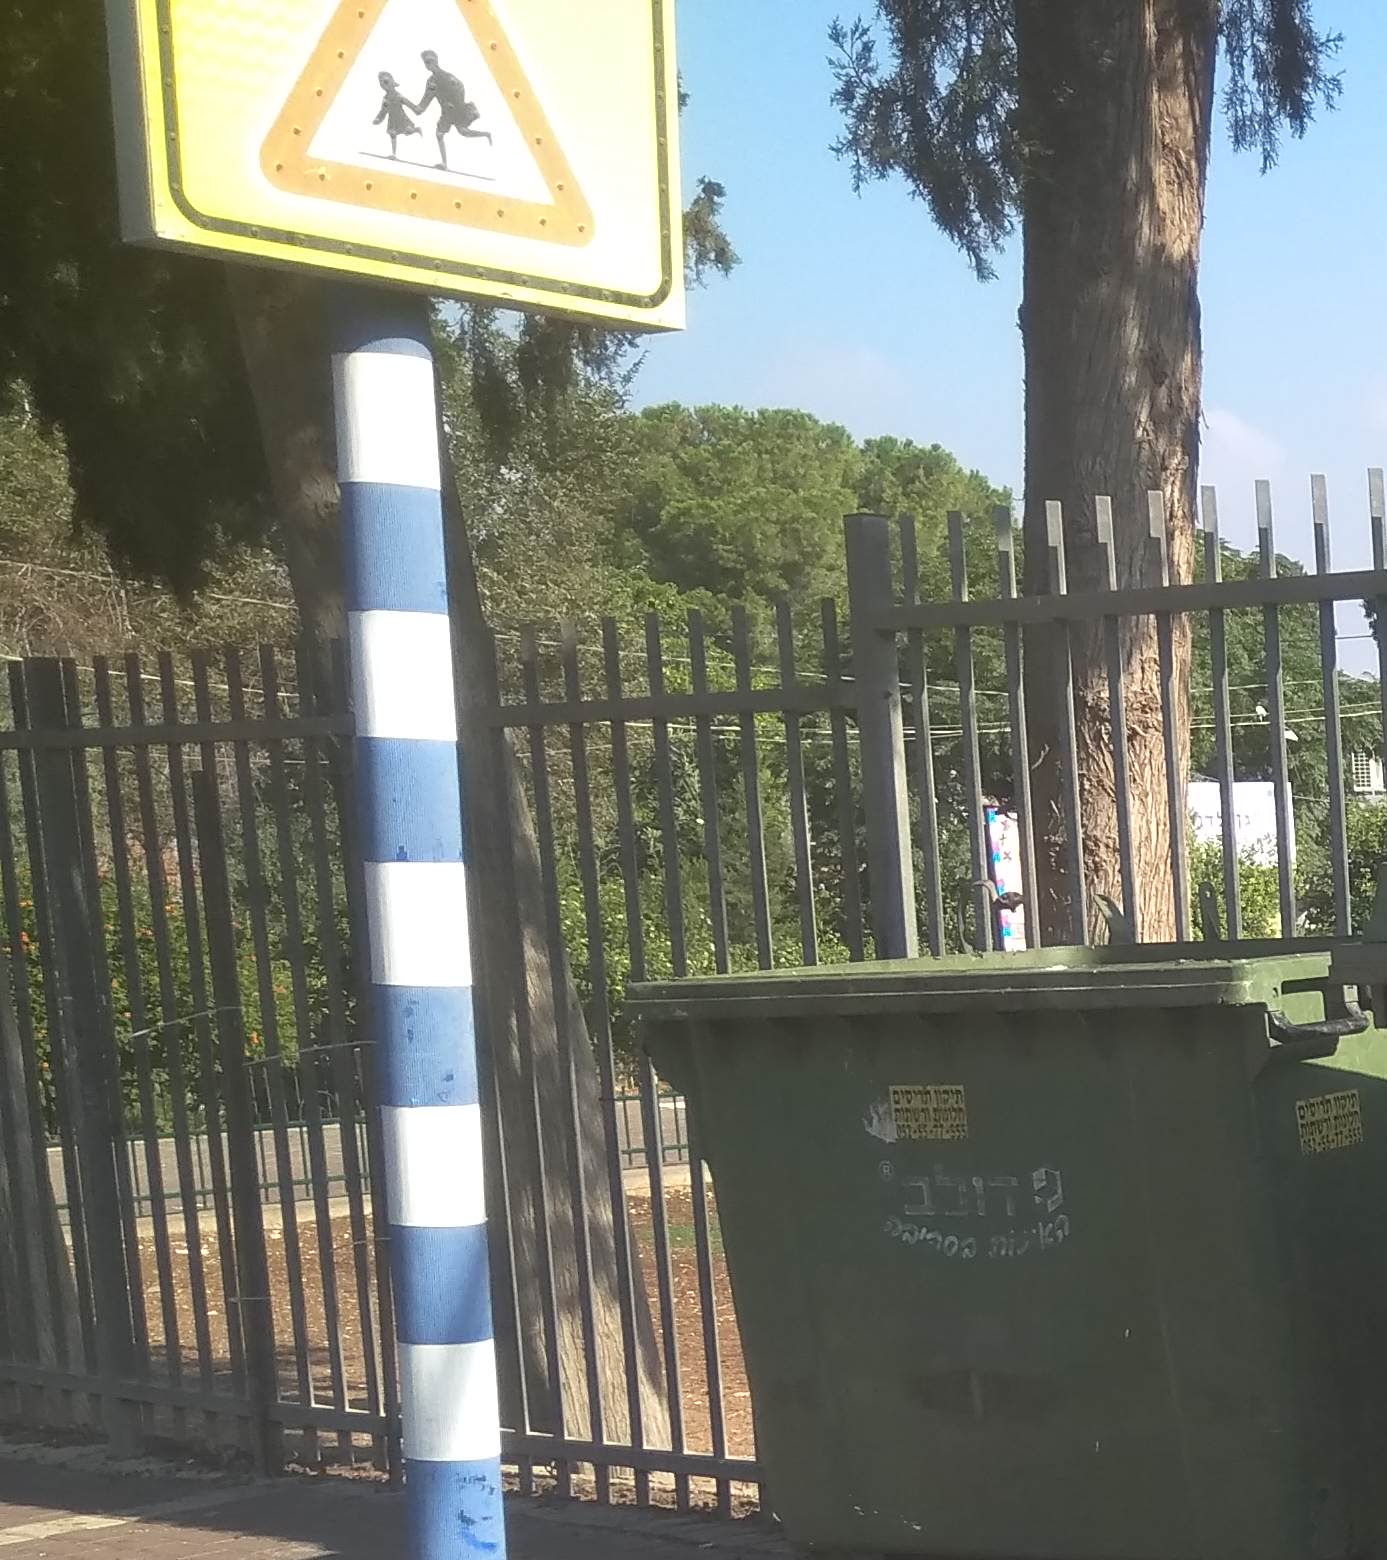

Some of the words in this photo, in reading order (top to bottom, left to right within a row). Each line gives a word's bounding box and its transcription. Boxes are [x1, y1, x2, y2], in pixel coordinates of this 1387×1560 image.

[892, 1088, 932, 1104] תריסים
[933, 1088, 962, 1105] תיקון
[1333, 1092, 1358, 1112] תיקון
[1298, 1099, 1332, 1120] תריסים
